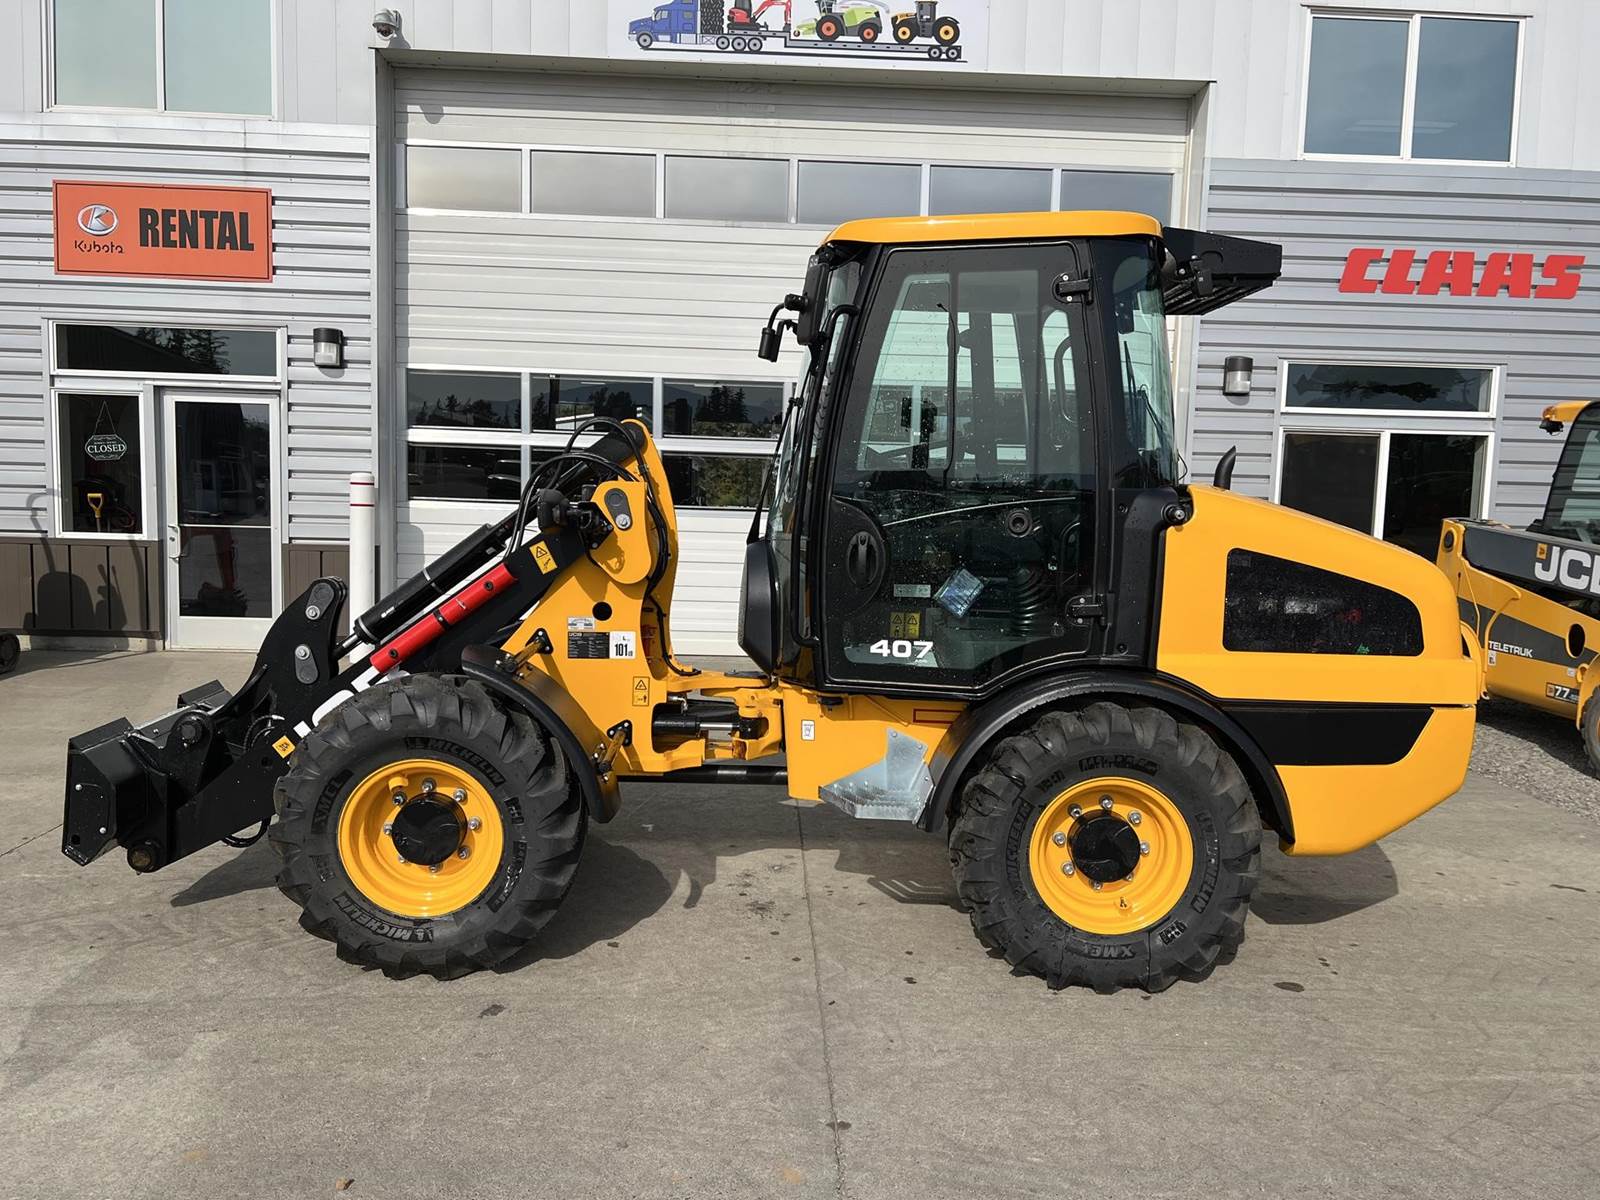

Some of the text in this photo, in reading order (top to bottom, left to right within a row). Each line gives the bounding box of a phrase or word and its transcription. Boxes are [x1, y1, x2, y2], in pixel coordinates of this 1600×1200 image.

[138, 207, 255, 251] RENTAL
[75, 240, 125, 254] Kubota
[1338, 248, 1586, 300] CLAAS
[88, 444, 126, 453] CLOSED
[615, 643, 628, 656] 101
[870, 640, 934, 658] 407
[1489, 641, 1534, 658] TELETRUK
[1555, 686, 1570, 698] 77
[428, 737, 506, 787] MICHELIN
[333, 892, 414, 941] MICHELIN
